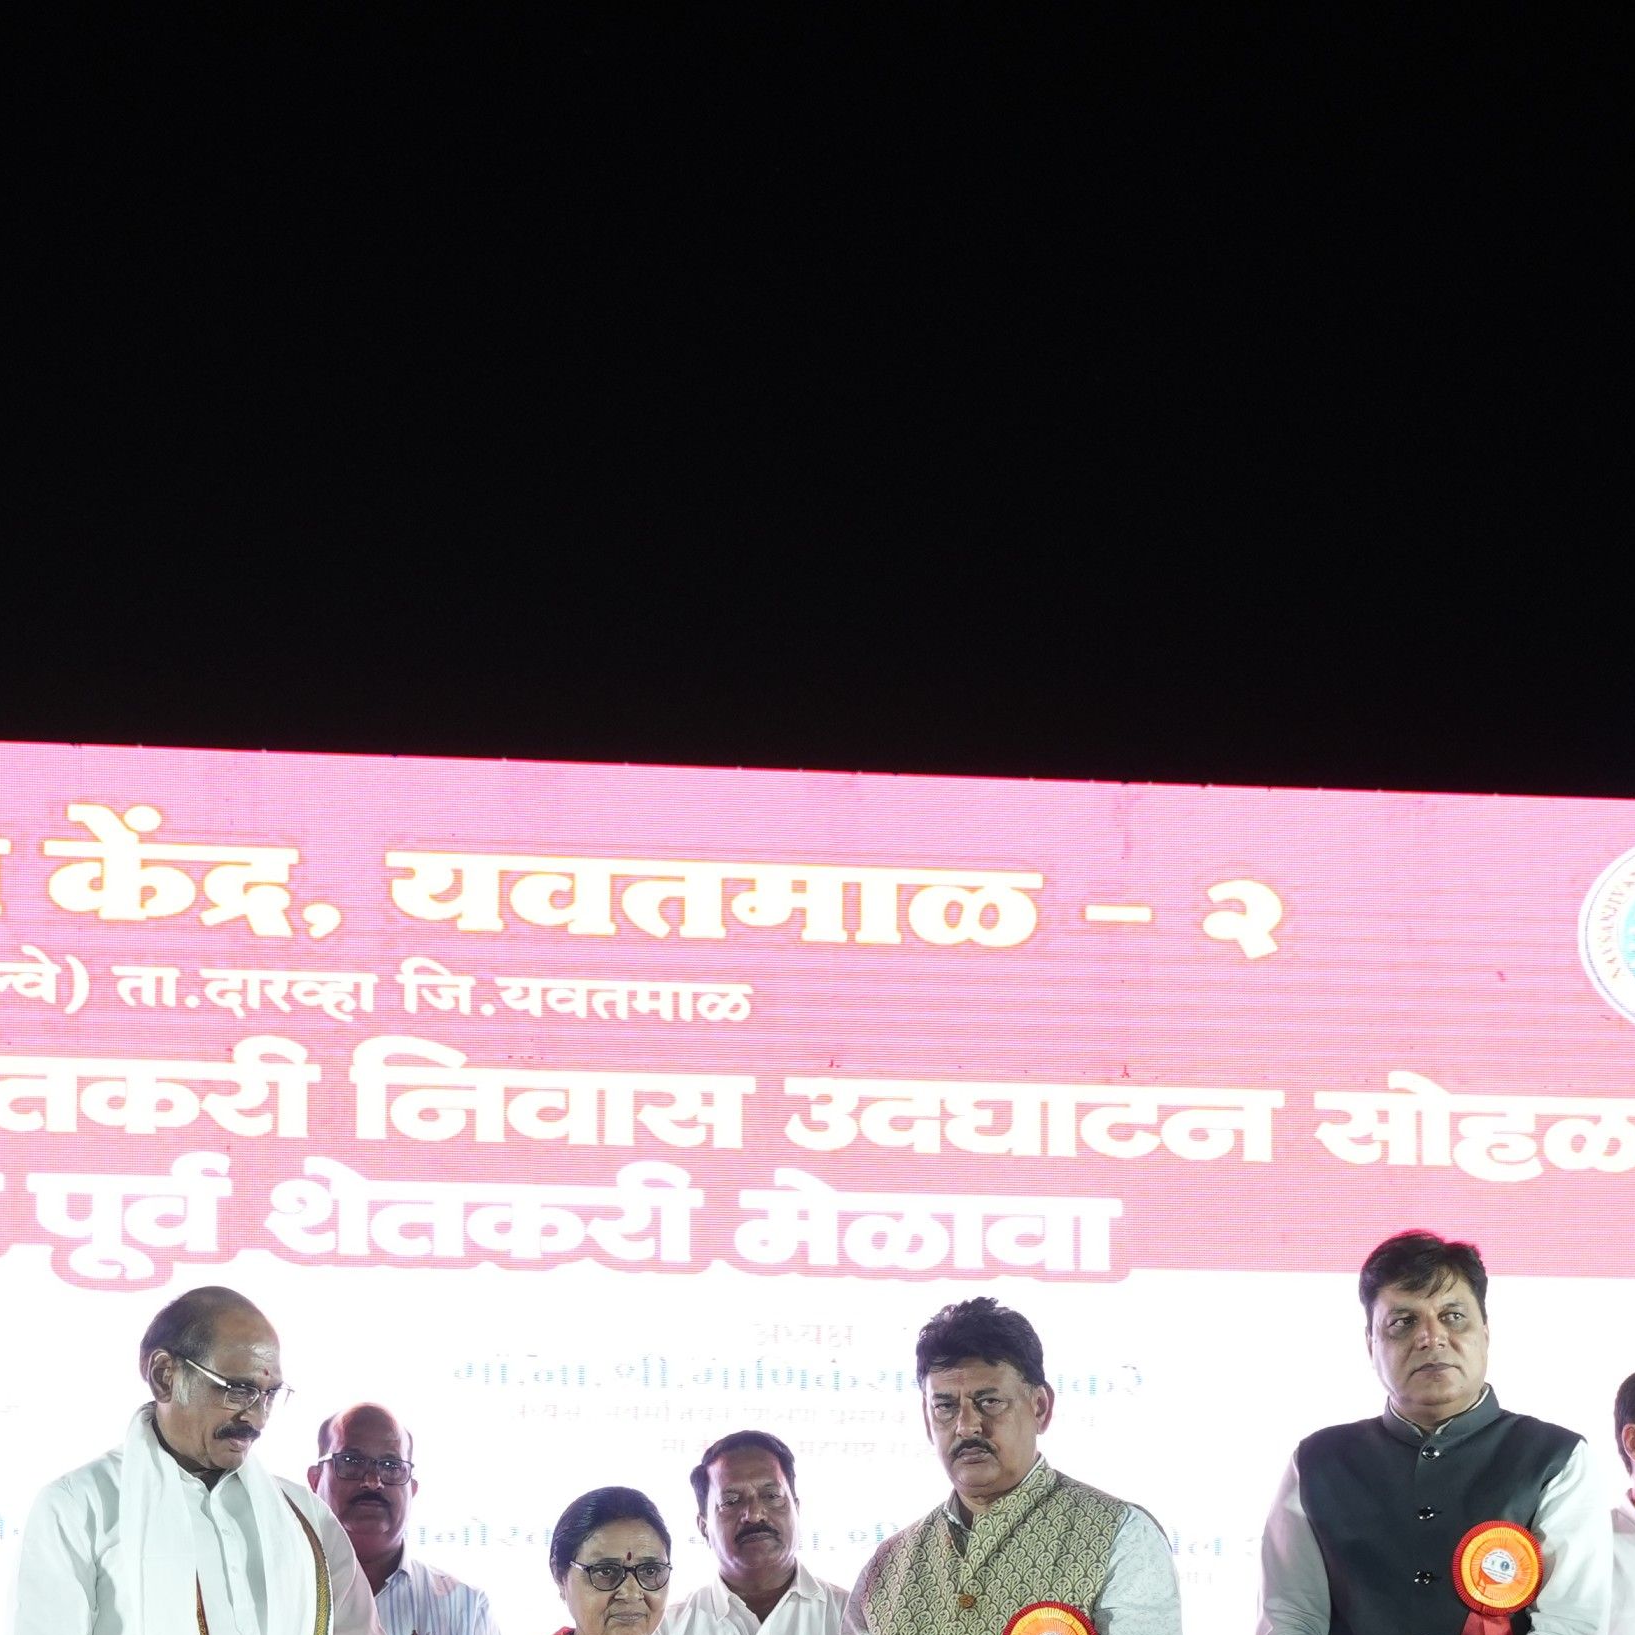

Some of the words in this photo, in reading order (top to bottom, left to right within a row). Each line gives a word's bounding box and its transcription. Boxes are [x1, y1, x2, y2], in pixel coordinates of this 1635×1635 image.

[43, 803, 342, 939] केंद्र,
[385, 850, 1044, 947] यवतमाळ
[1202, 878, 1285, 960] २
[395, 956, 755, 1027] जि.यवतमाळ
[348, 1034, 759, 1150] निवास
[24, 1150, 233, 1281] पूर्व
[263, 1155, 705, 1264] शेतकरी
[732, 1166, 1124, 1273] मेळावा
